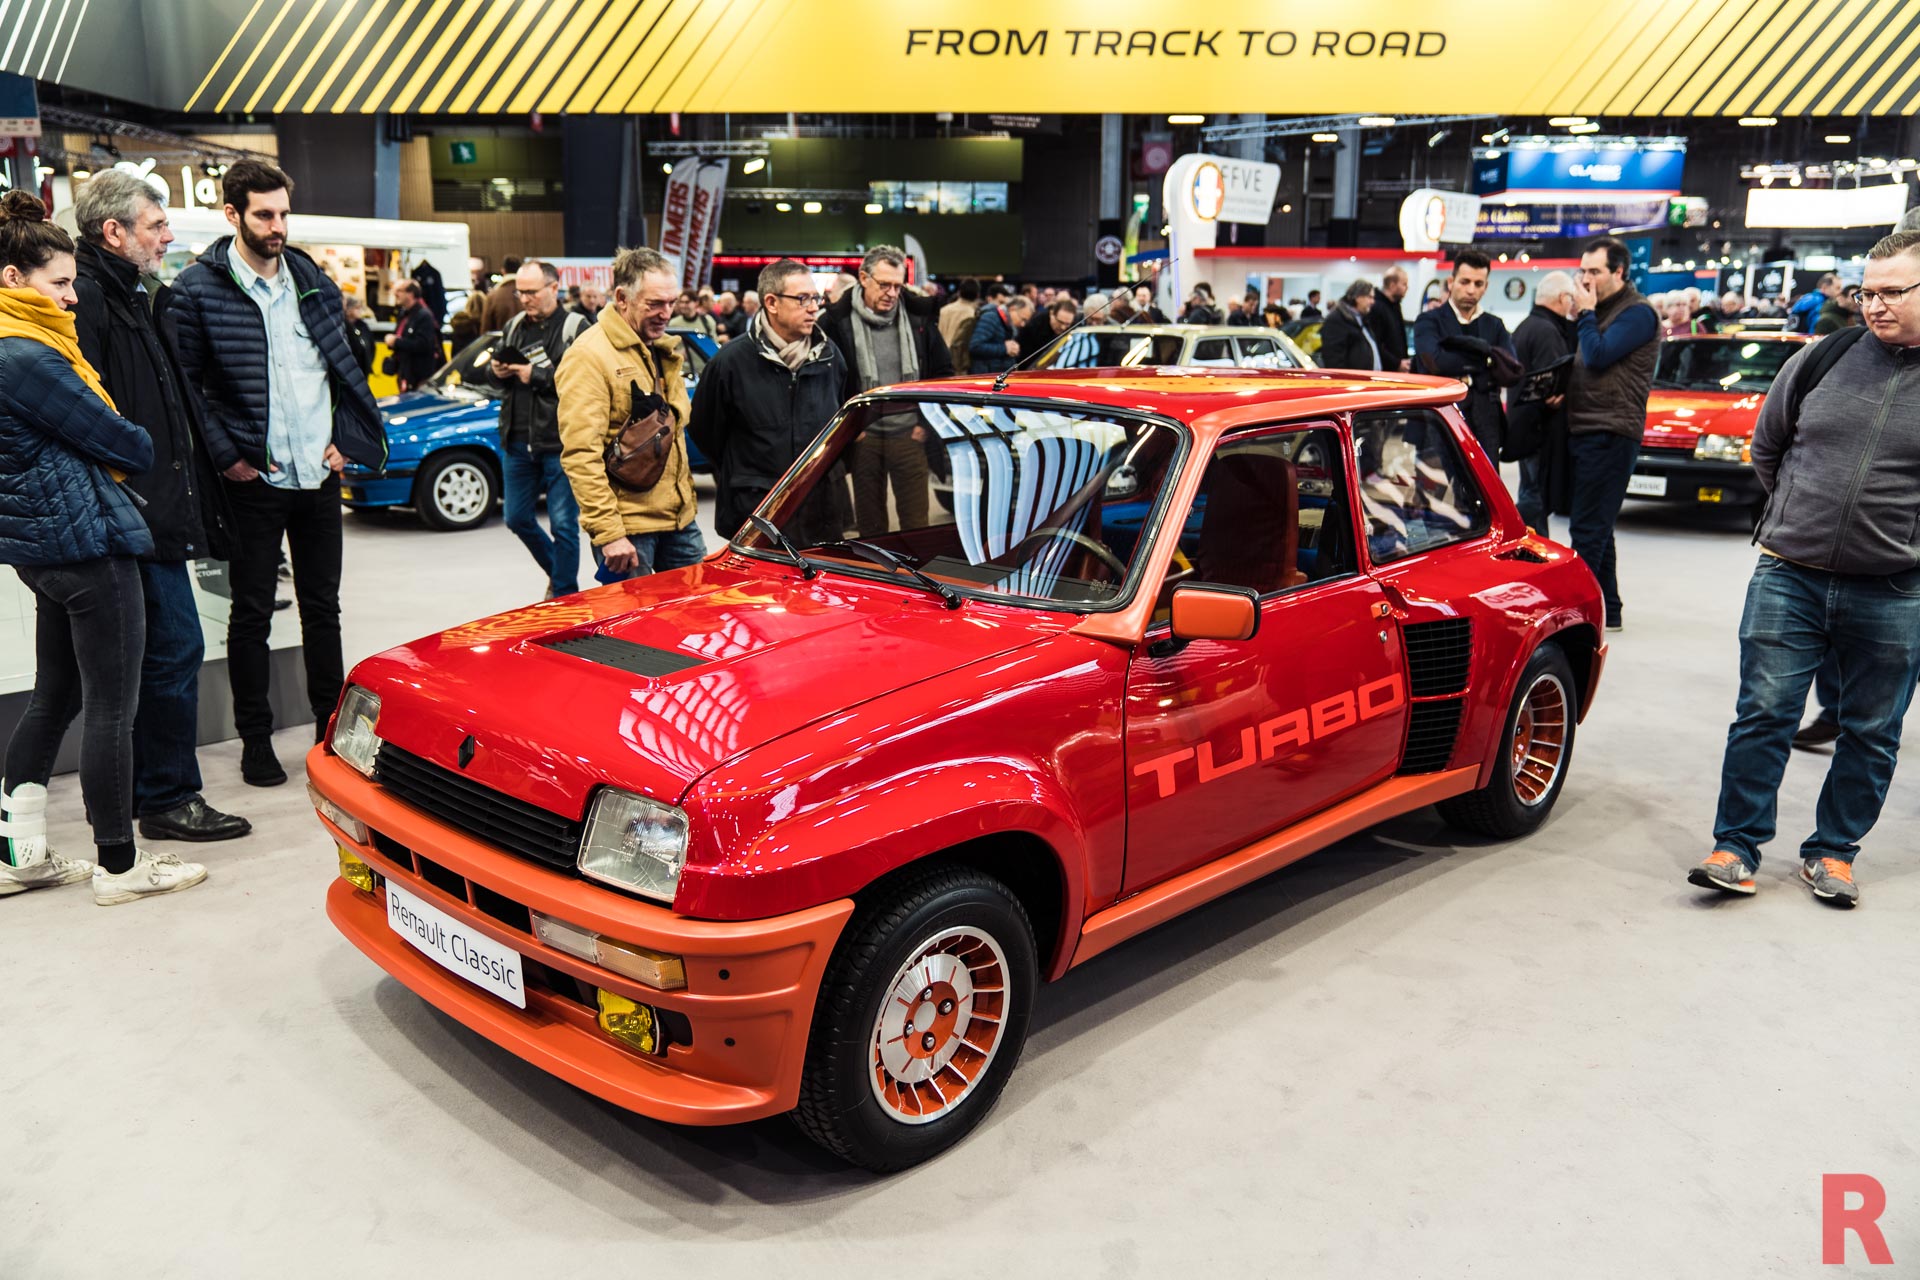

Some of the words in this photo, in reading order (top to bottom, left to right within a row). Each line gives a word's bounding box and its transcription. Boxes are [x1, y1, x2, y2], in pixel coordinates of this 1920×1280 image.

[905, 29, 1049, 56] FROM
[1064, 30, 1224, 57] TRACK
[1237, 30, 1297, 56] TO
[1311, 31, 1448, 57] ROAD
[1133, 672, 1405, 798] TURBO
[390, 892, 448, 954] Renault
[450, 934, 517, 991] Classic
